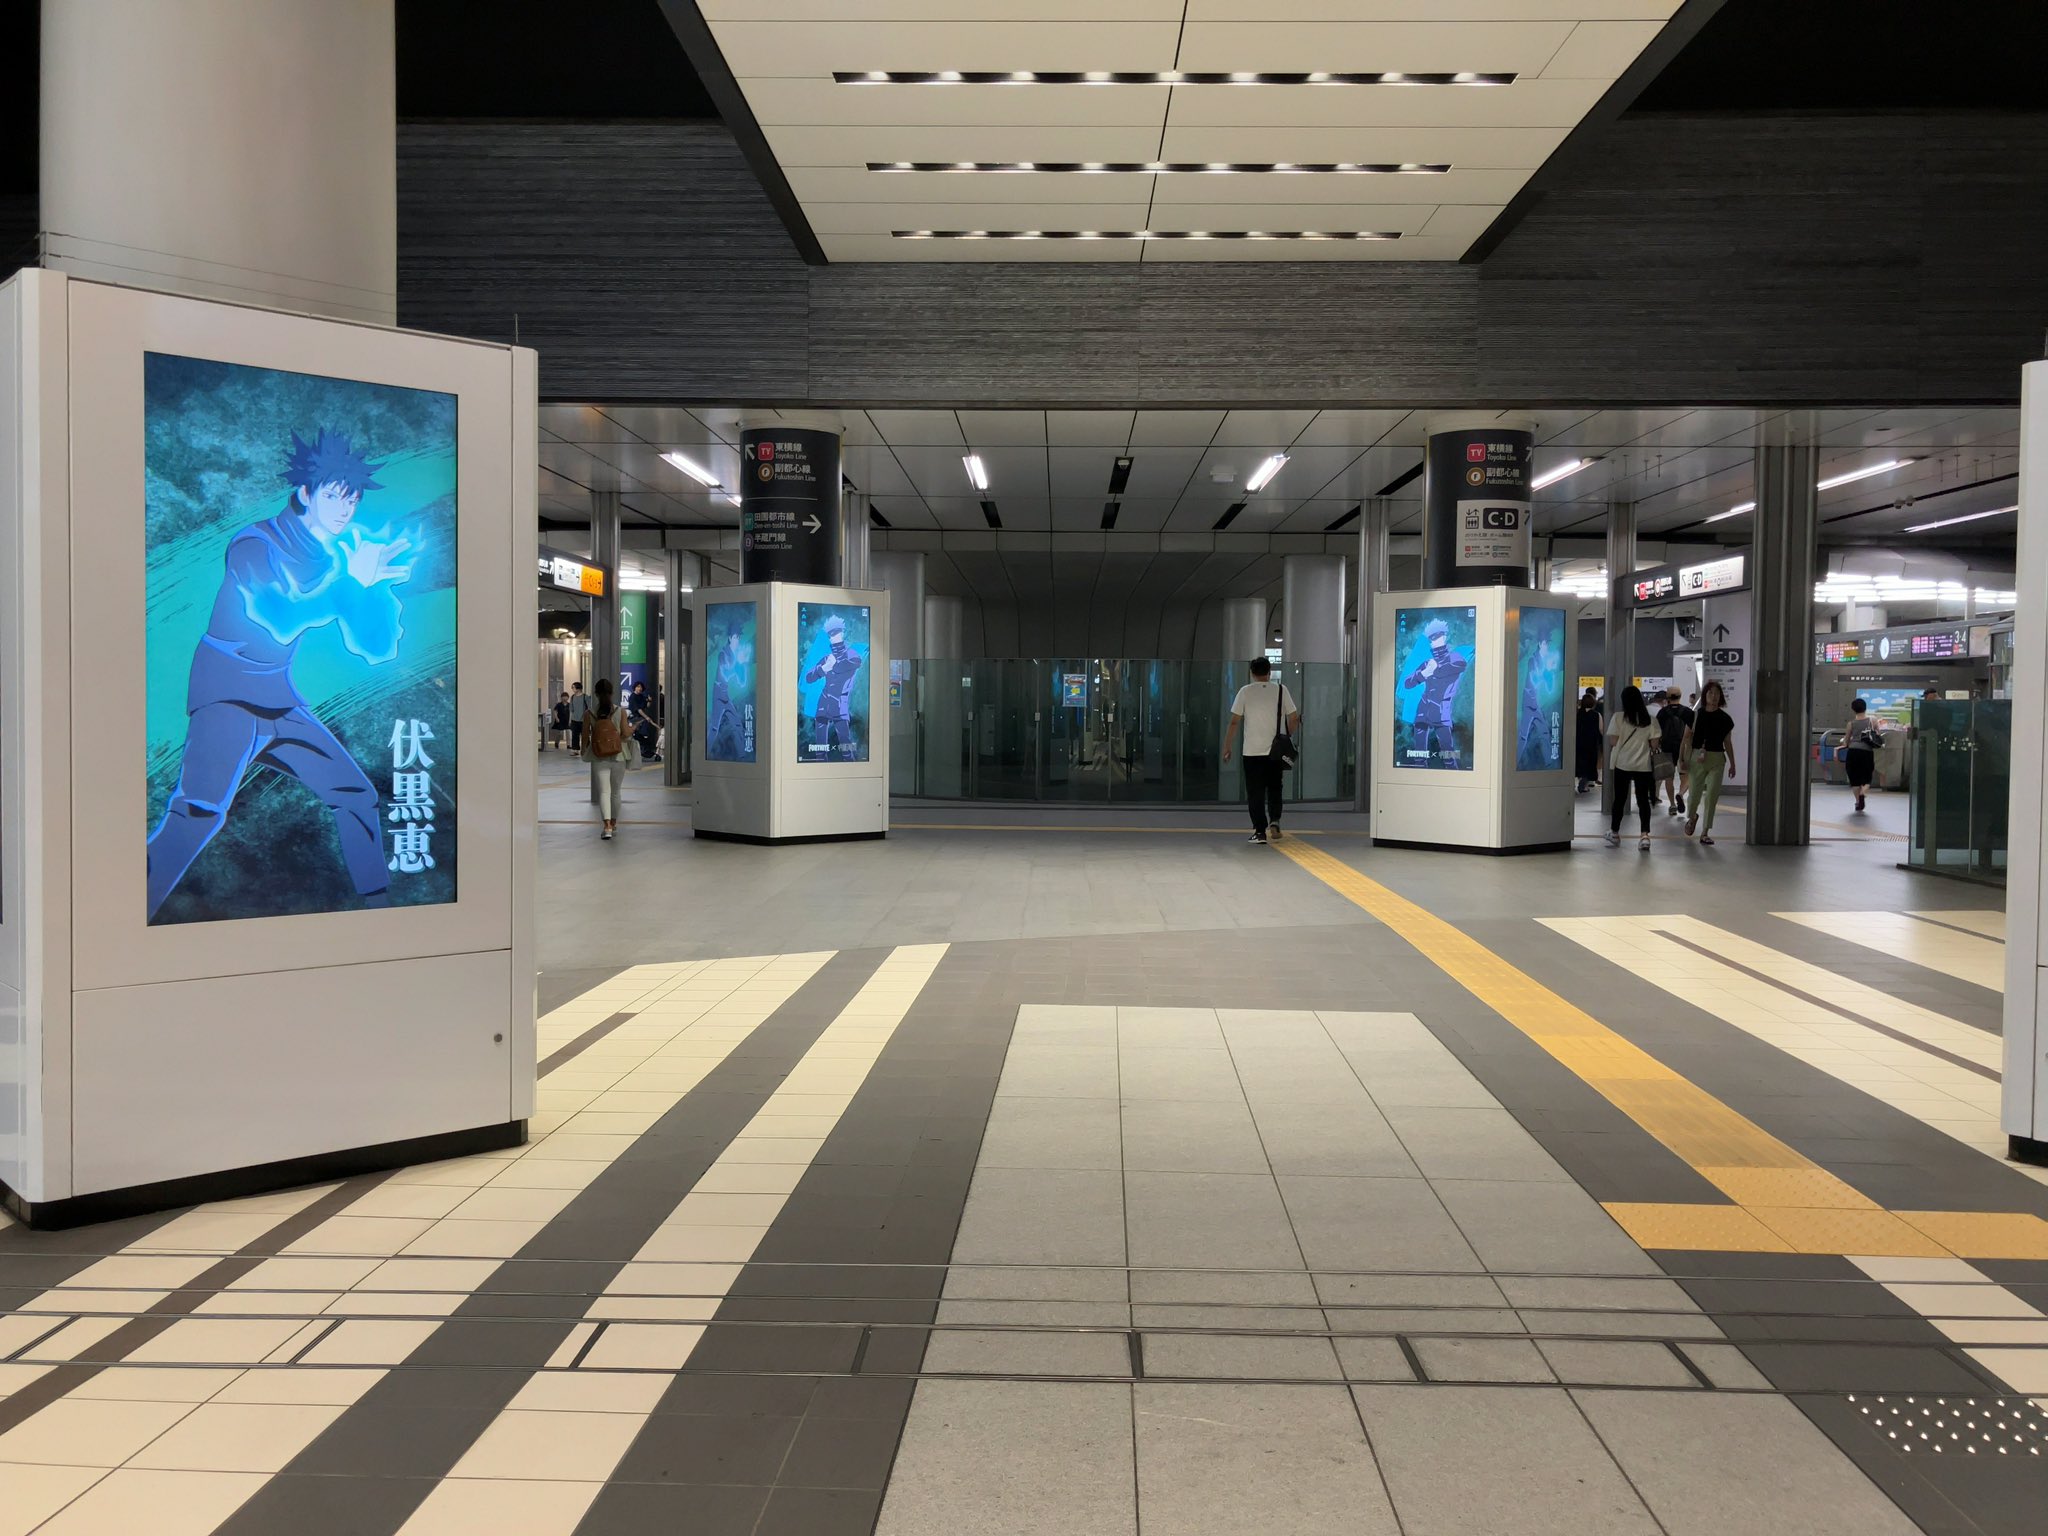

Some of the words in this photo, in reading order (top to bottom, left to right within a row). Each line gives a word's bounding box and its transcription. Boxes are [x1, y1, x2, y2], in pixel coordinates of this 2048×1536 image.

[761, 447, 772, 455] TY
[775, 442, 803, 452] 東横線
[1487, 443, 1513, 453] 東横線
[1470, 449, 1482, 457] TY
[1487, 453, 1507, 462] Toyoko
[775, 463, 811, 474] 副都心線
[1486, 467, 1520, 478] 副都心線
[620, 630, 630, 641] JR
[744, 704, 754, 752] 伏黒恵
[808, 744, 830, 752] FORTNITE
[1406, 749, 1430, 759] FORTNITE
[387, 718, 436, 873] 伏黒恵
